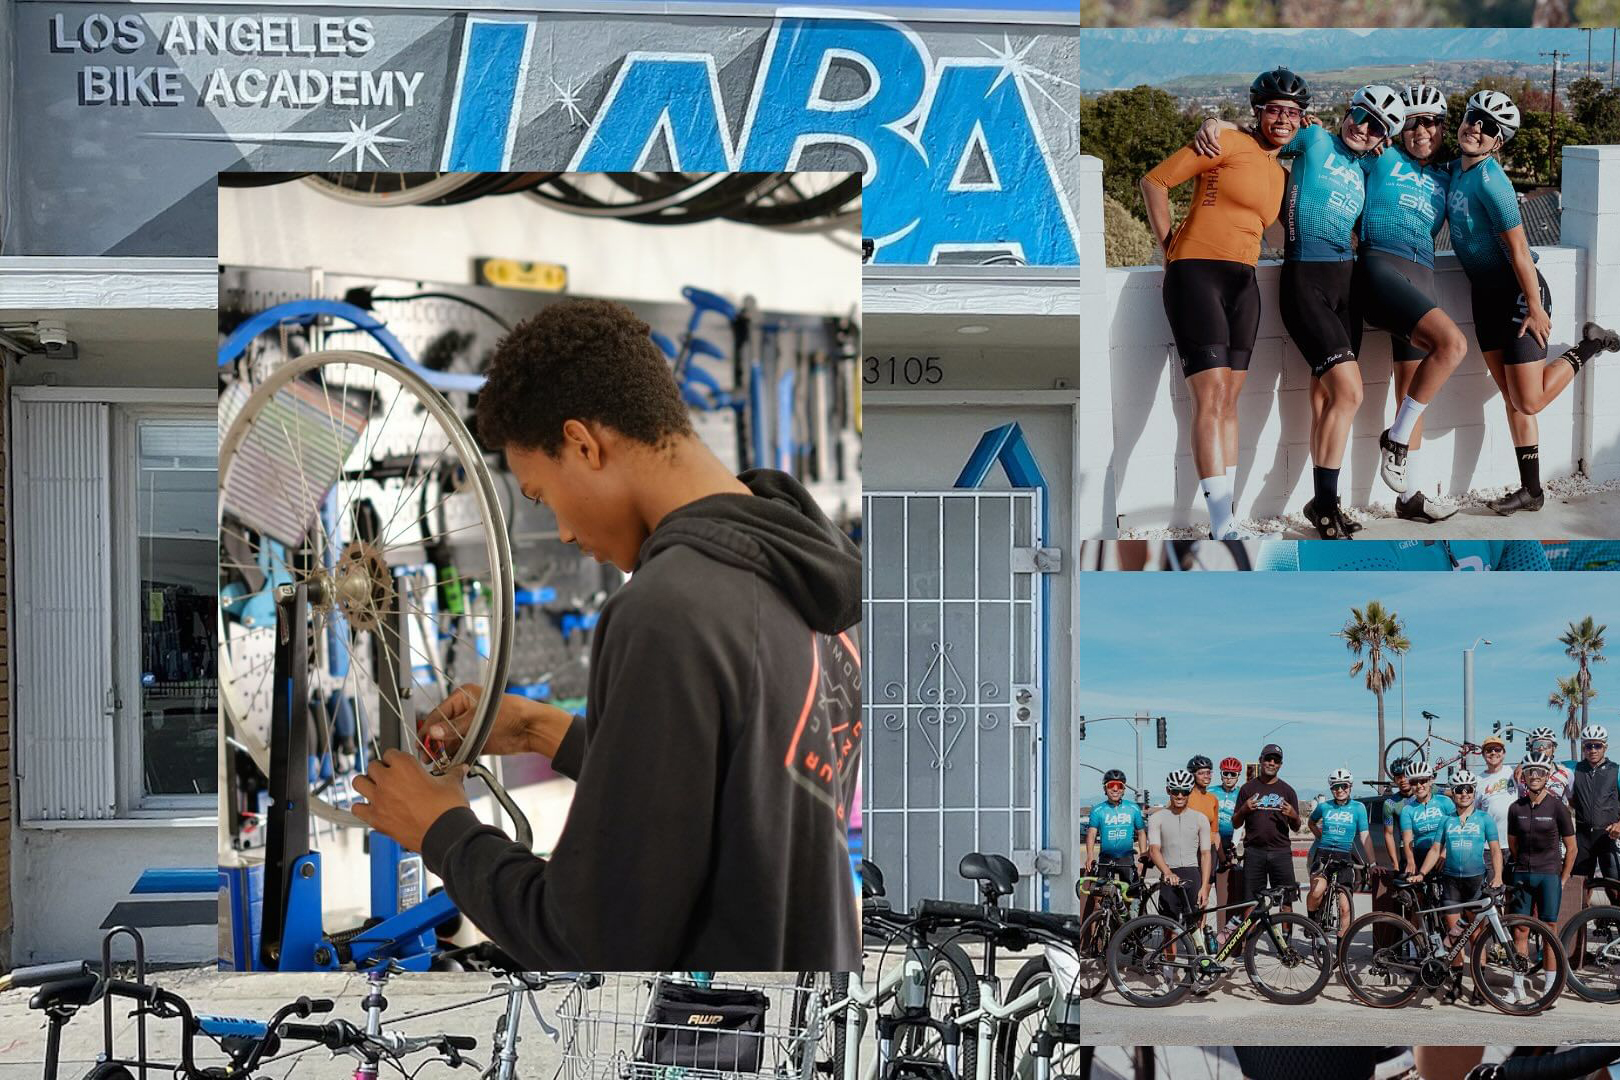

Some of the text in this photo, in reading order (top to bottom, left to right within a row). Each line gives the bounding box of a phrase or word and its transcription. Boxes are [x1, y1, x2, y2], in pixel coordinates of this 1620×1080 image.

[53, 12, 377, 55] LOS ANGELES
[83, 64, 425, 107] BIKE ACADEMY
[1202, 165, 1219, 207] RAPHA
[1288, 184, 1299, 242] cannondale
[862, 356, 943, 385] 3105
[1105, 813, 1132, 825] LABA
[1325, 810, 1353, 823] LABA
[1414, 807, 1443, 822] LABA
[1447, 822, 1480, 835] LABA
[1447, 919, 1480, 961] cannondale
